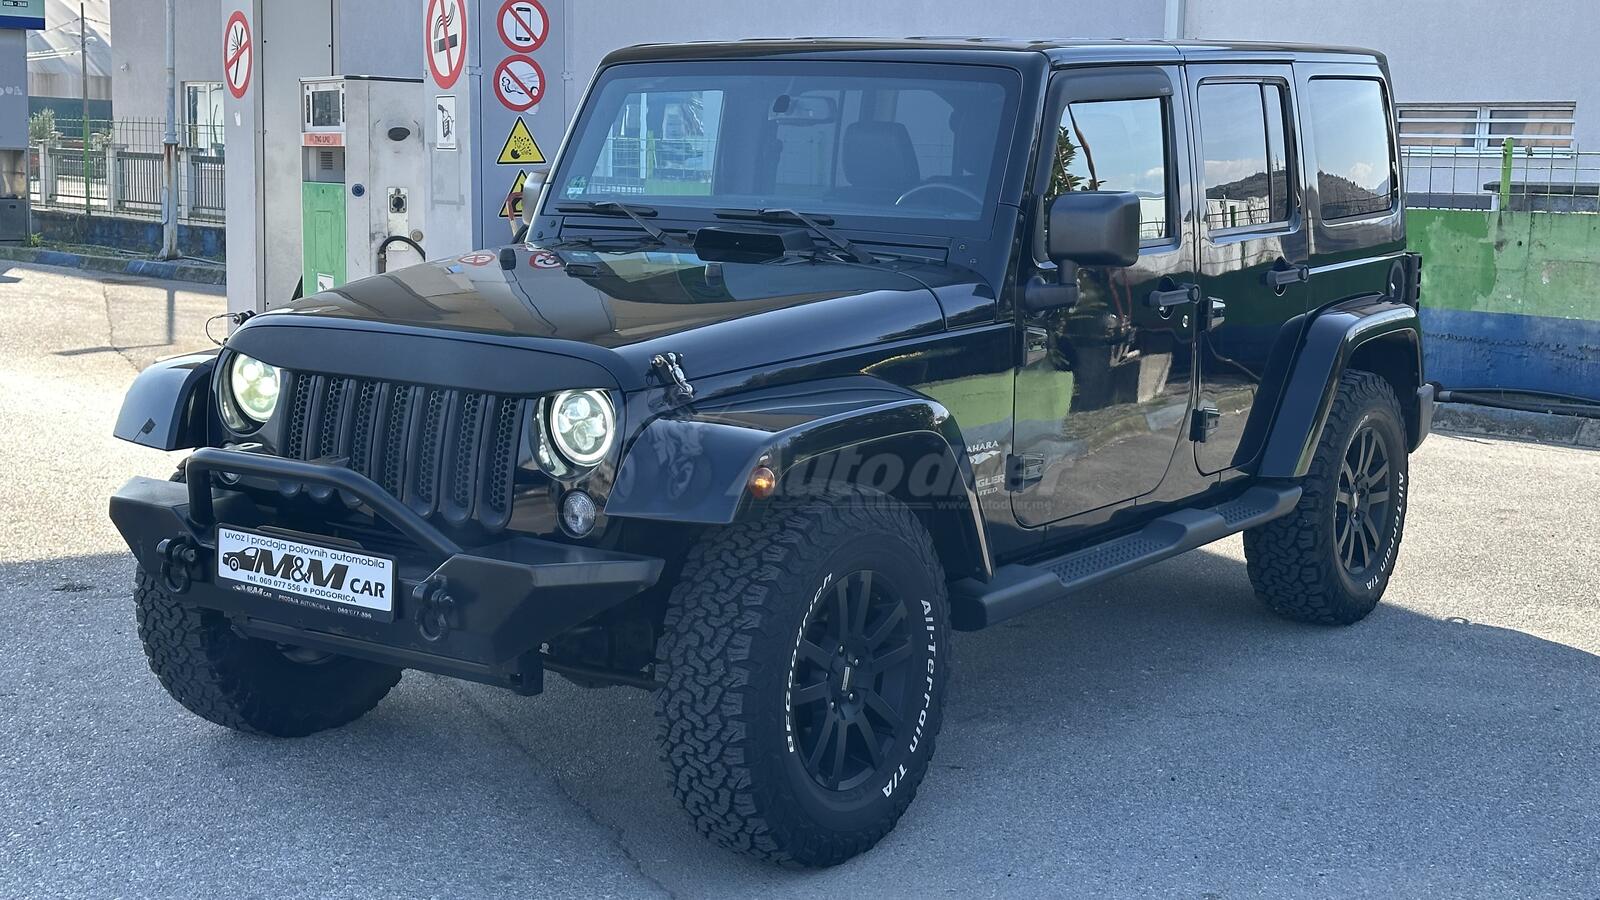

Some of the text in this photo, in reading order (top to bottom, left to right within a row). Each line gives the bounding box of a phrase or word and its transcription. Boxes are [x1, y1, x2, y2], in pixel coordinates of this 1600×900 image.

[966, 440, 999, 453] AHARA
[976, 474, 1005, 487] GLER
[1380, 471, 1404, 573] All-Terrain
[224, 531, 385, 569] uvoz i prodaja polovnih automobila
[247, 574, 258, 583] tel.
[259, 576, 272, 585] 069
[273, 579, 286, 588] 077
[309, 587, 357, 603] PODGORICA
[254, 548, 386, 599] M&M CAR
[785, 572, 833, 753] BFGoodrich
[882, 599, 937, 798] All-Terrain T/A
